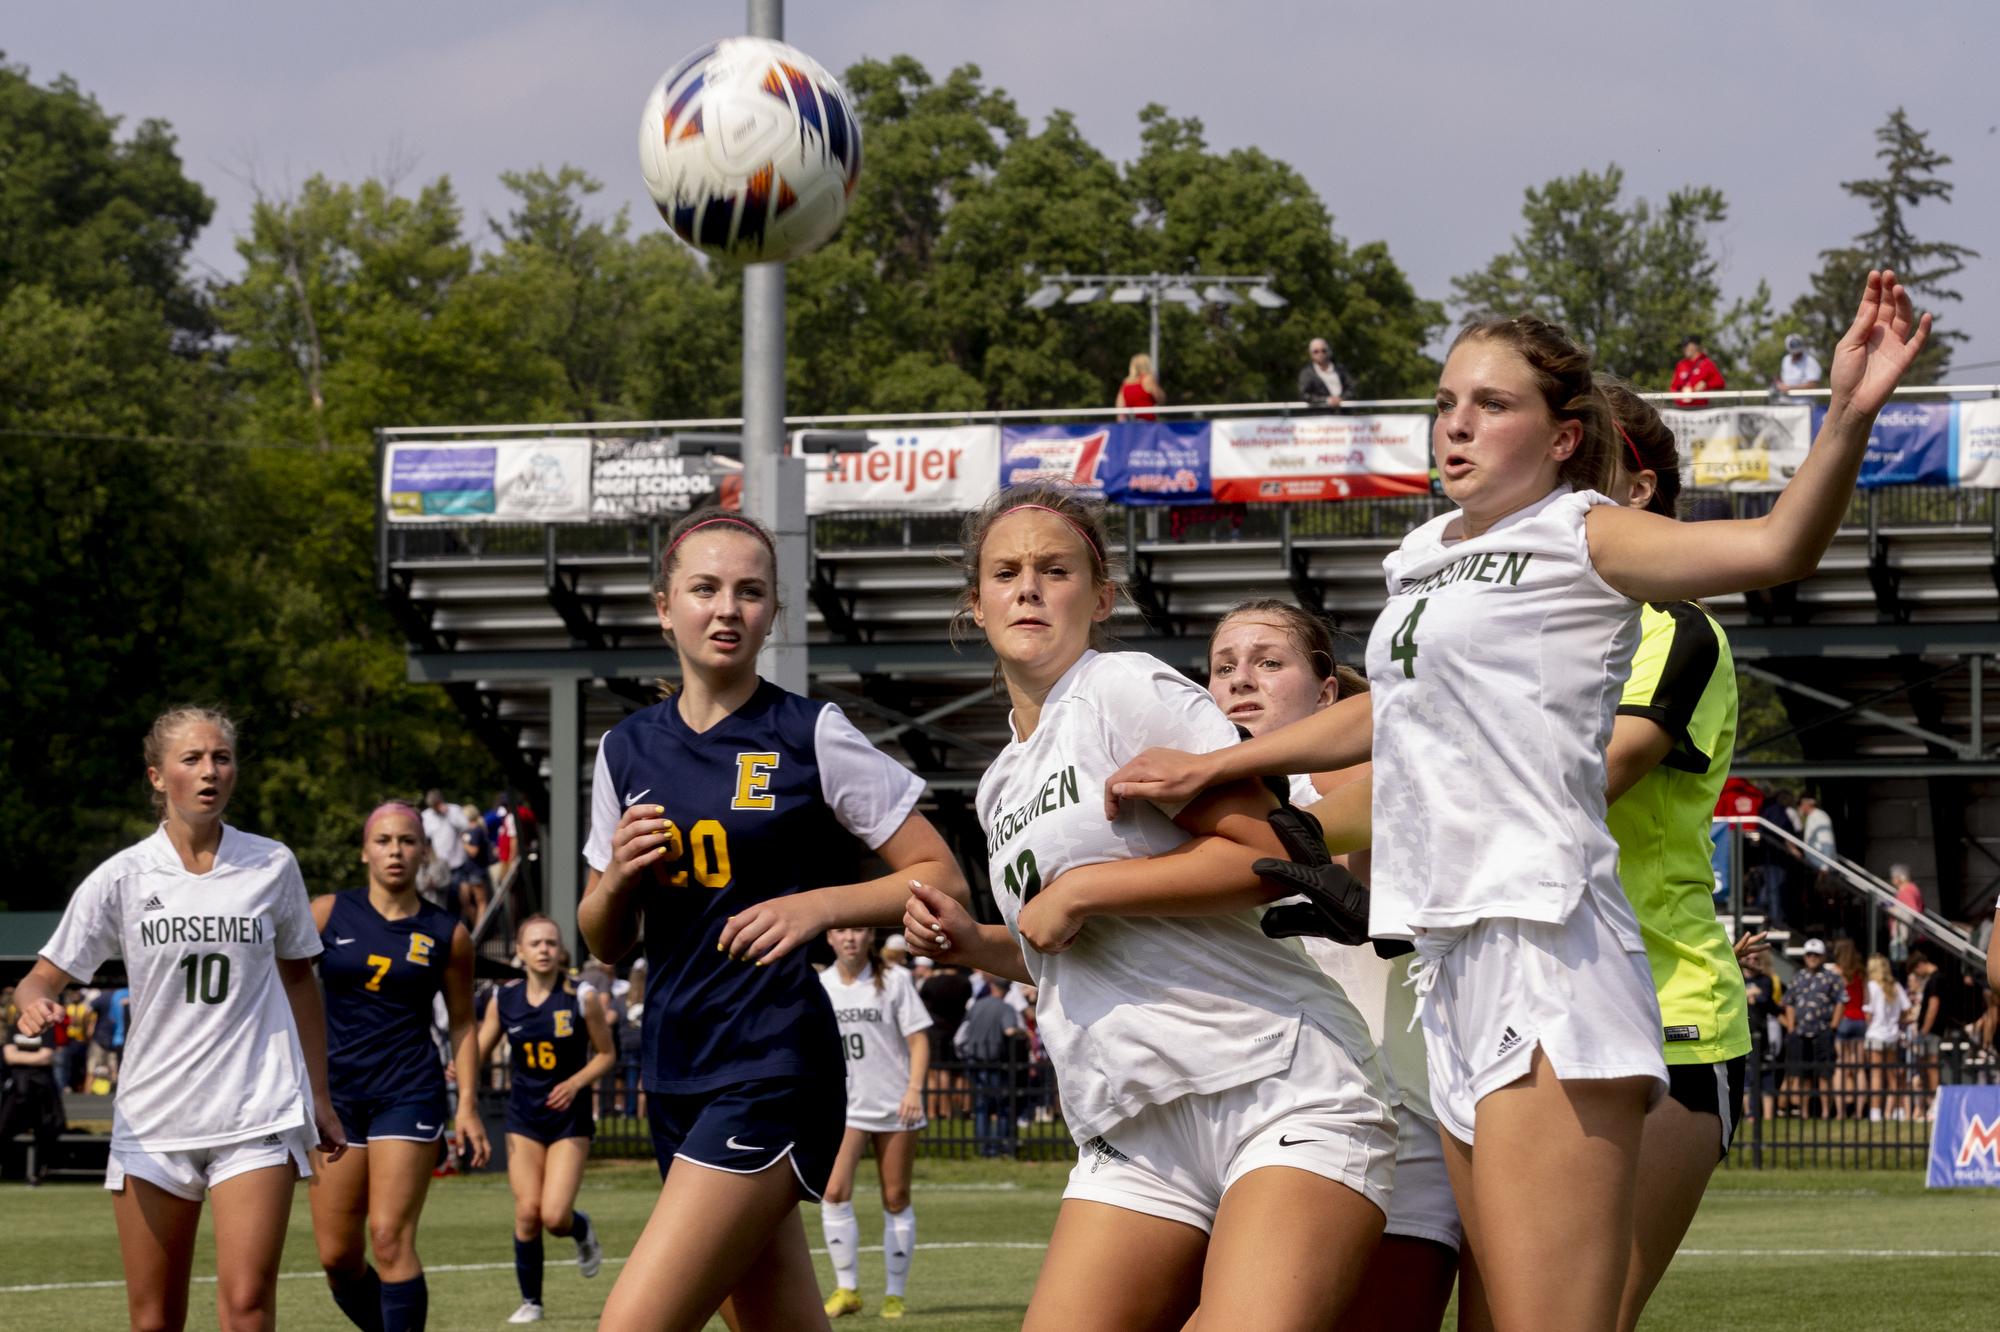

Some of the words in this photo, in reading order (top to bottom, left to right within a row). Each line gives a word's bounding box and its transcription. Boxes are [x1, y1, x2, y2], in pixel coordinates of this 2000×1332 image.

[593, 457, 685, 477] MICHIGAN
[826, 437, 963, 493] meijer
[592, 477, 637, 496] HIGH
[637, 474, 715, 496] SCHOOL
[1390, 597, 1430, 679] 4
[731, 752, 781, 811] E
[650, 819, 732, 888] 20
[141, 916, 263, 947] NORSEMEN
[406, 932, 435, 966] E
[180, 952, 231, 1005] 10
[364, 954, 392, 992] 7
[553, 1009, 573, 1038] E
[523, 1041, 557, 1070] 16
[841, 1033, 865, 1061] 19
[263, 1139, 283, 1147] adidas
